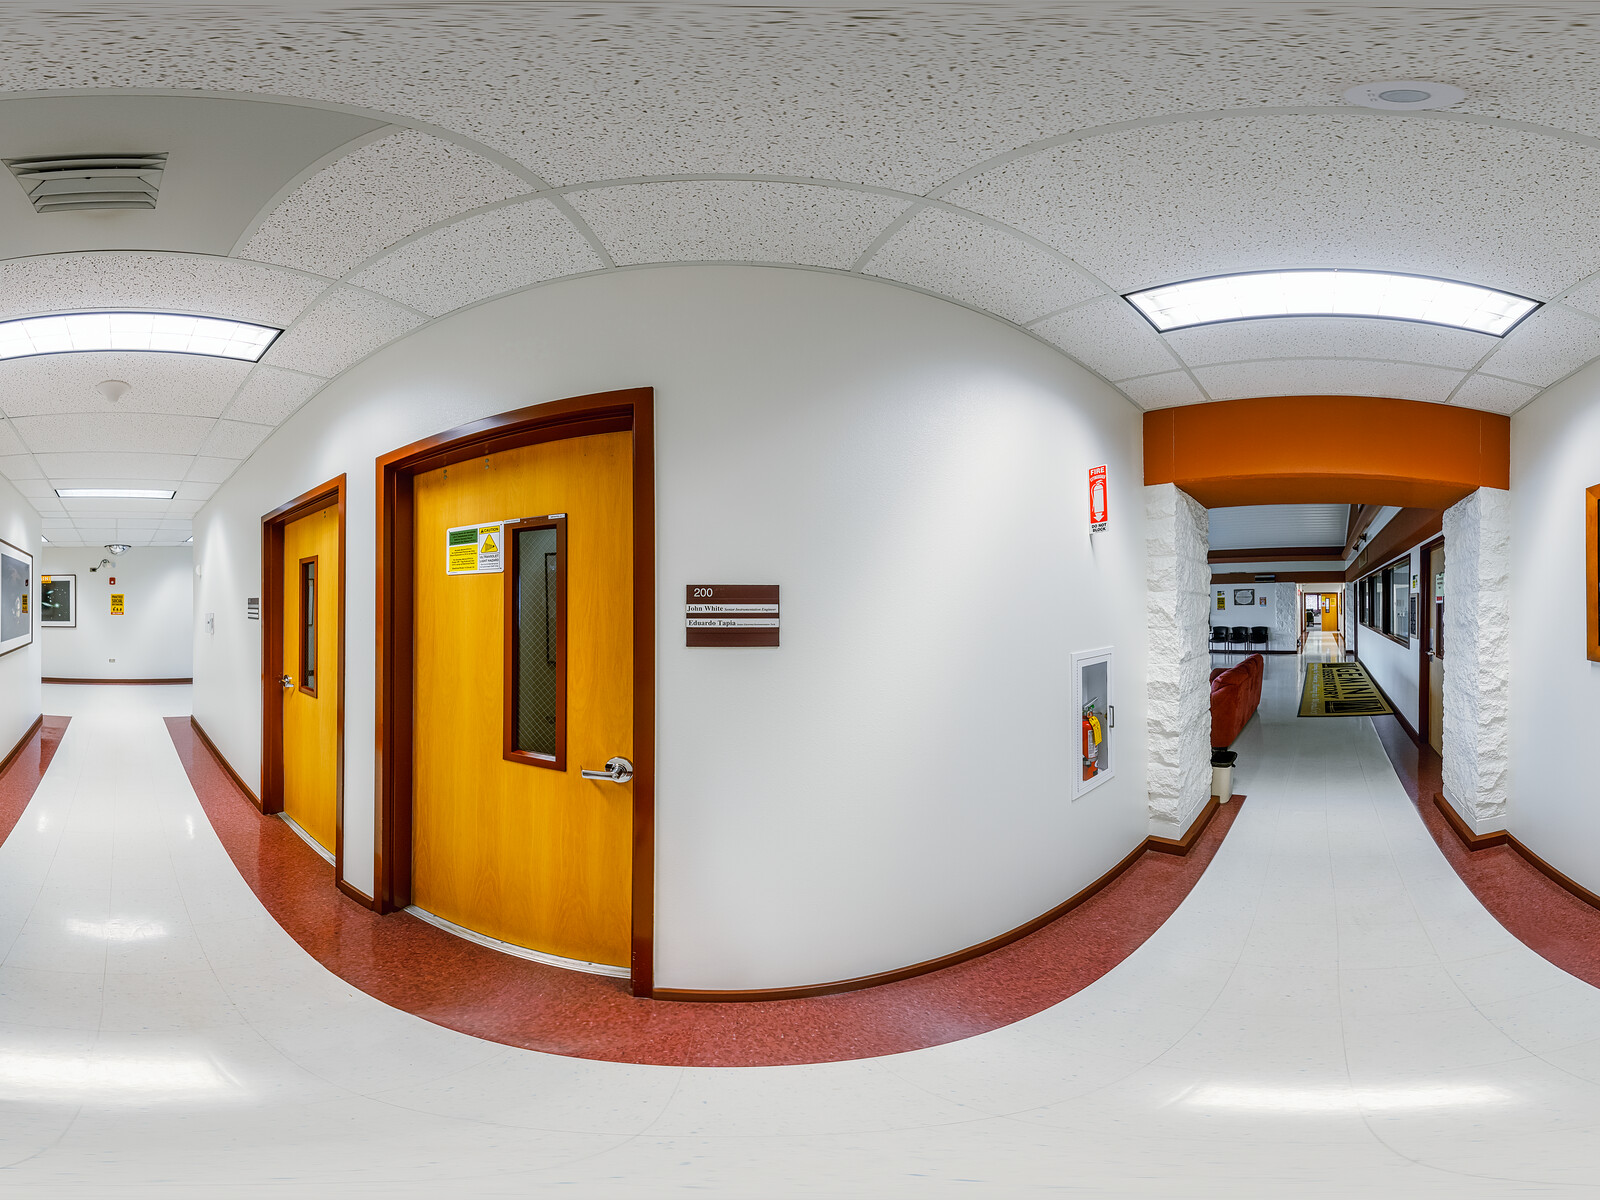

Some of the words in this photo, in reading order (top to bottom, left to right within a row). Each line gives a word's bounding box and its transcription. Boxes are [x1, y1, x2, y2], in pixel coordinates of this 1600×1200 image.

[1091, 467, 1104, 475] FIRE
[693, 587, 713, 598] 200
[1322, 668, 1339, 699] OBSERVATORY
[1336, 667, 1377, 699] GEMINI
